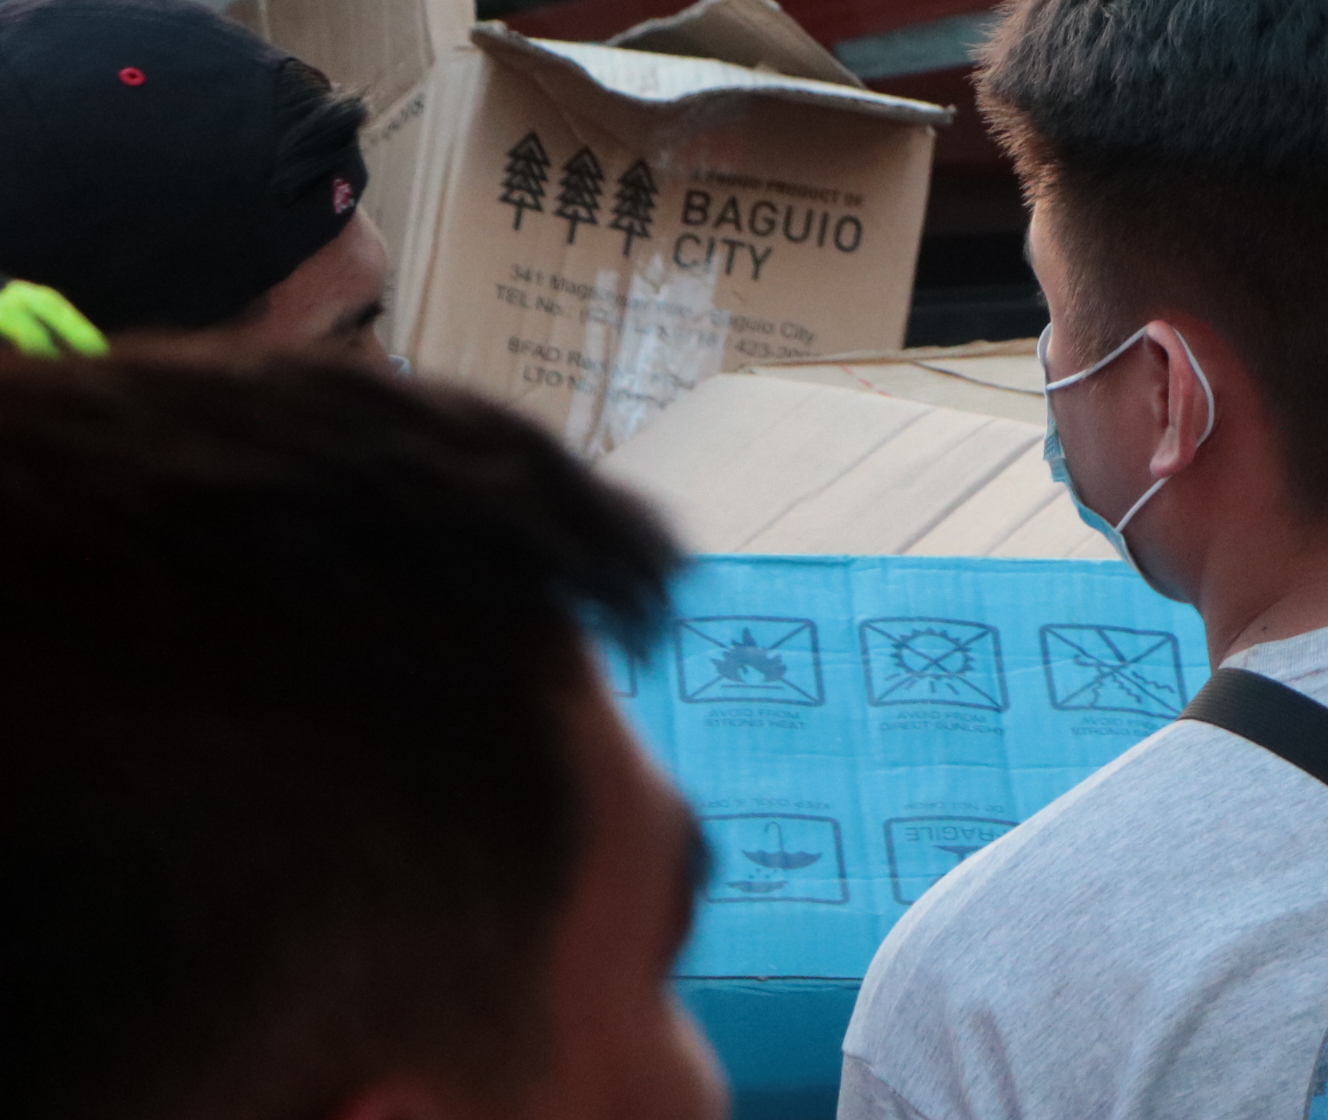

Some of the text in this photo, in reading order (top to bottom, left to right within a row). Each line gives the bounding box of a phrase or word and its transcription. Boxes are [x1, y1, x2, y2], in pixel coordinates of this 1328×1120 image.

[681, 188, 864, 254] BAGUIO
[673, 232, 774, 282] CITY
[497, 283, 529, 309] TEL
